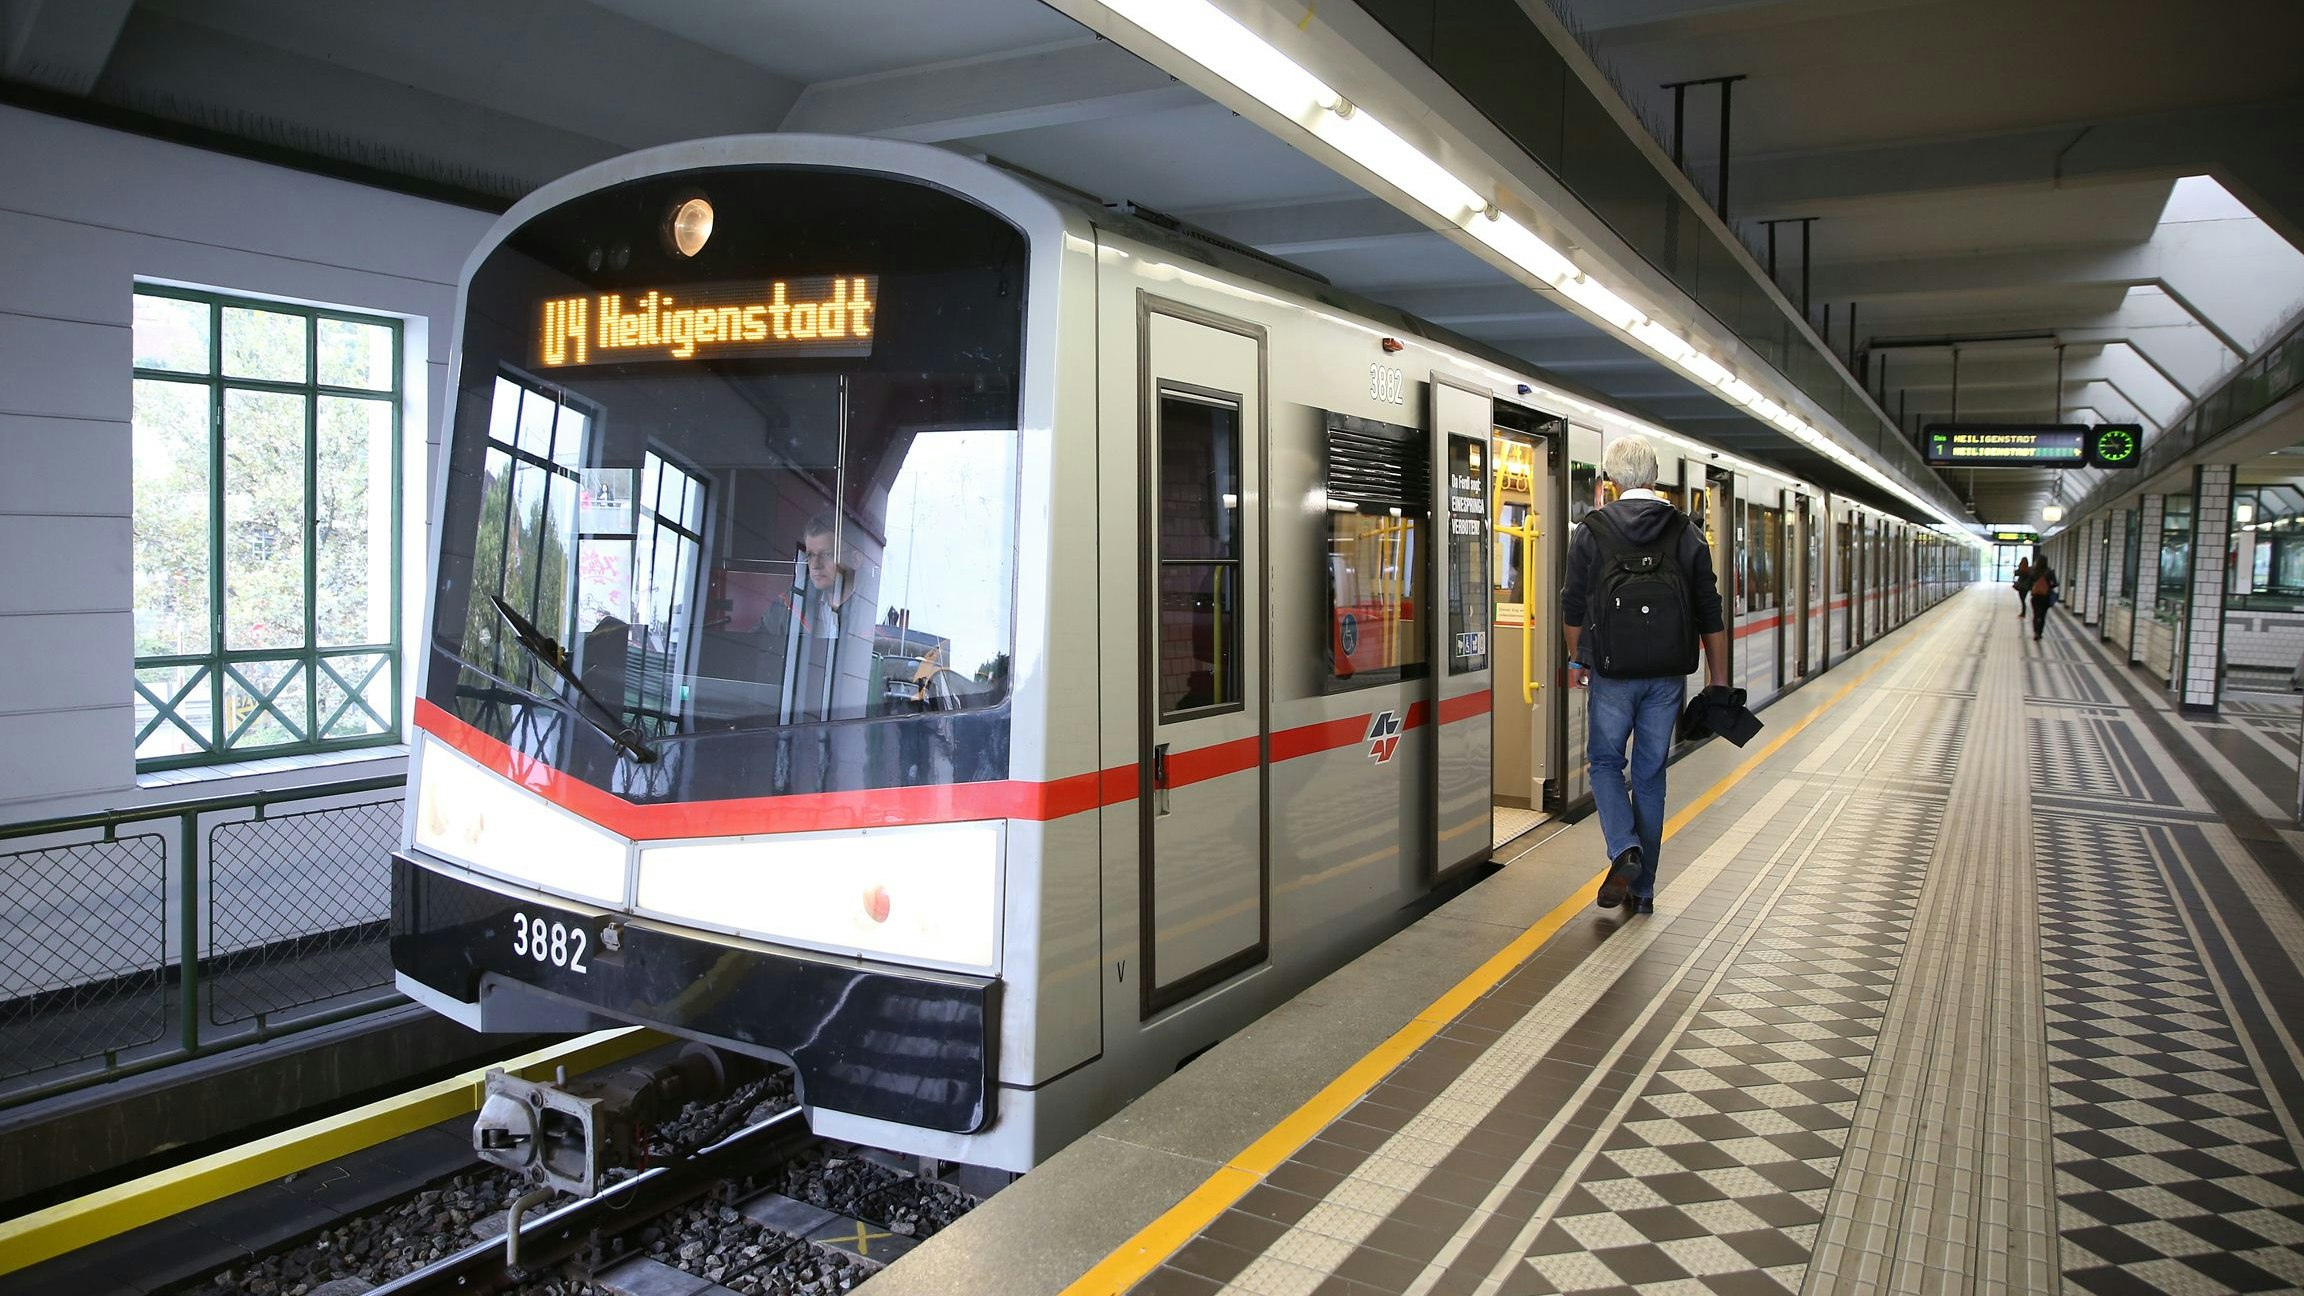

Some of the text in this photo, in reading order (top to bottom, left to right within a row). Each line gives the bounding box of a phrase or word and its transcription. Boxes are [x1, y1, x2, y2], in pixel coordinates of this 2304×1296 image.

[545, 278, 872, 365] U4 Heiligenstadt
[1369, 362, 1403, 406] 3882
[1952, 446, 2036, 457] HEILIGENSTADT
[1953, 434, 2037, 444] HEILIGENSTADT
[513, 912, 588, 974] 3882
